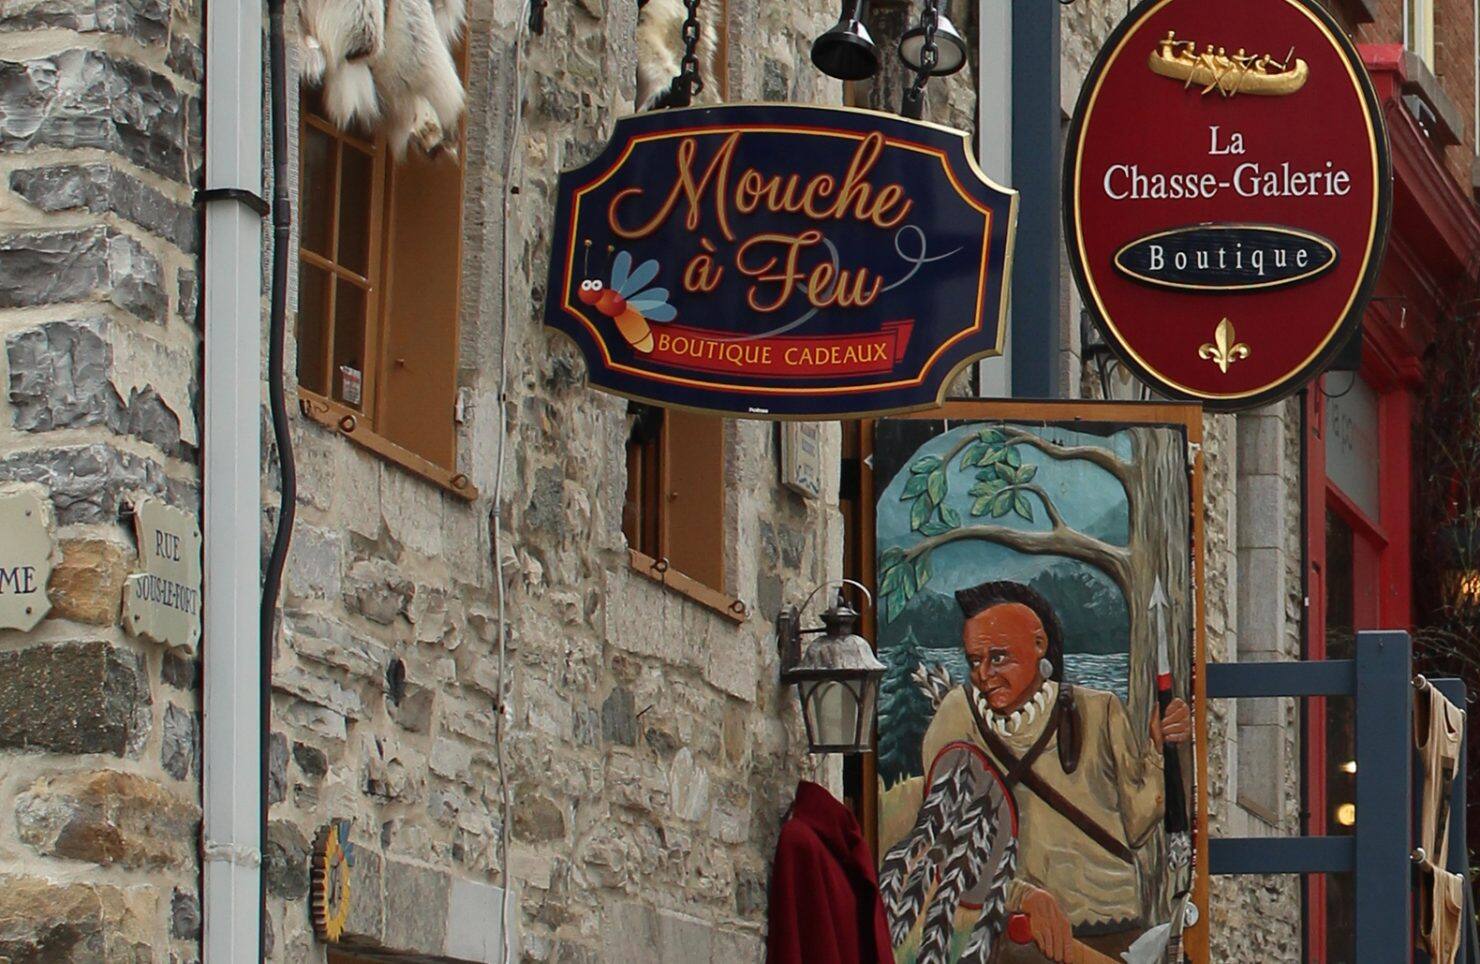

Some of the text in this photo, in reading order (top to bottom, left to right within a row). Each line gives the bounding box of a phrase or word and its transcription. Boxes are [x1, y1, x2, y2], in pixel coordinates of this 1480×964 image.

[1208, 125, 1246, 155] La
[608, 130, 913, 241] Mouche
[1103, 161, 1351, 199] Chasse-Galerie
[683, 230, 884, 312] à Feu
[1149, 243, 1309, 276] Boutique
[658, 333, 888, 366] BOUTIQUE CADEAUX
[156, 529, 181, 562] RUE
[136, 575, 198, 616] SOUS-LE-FORT
